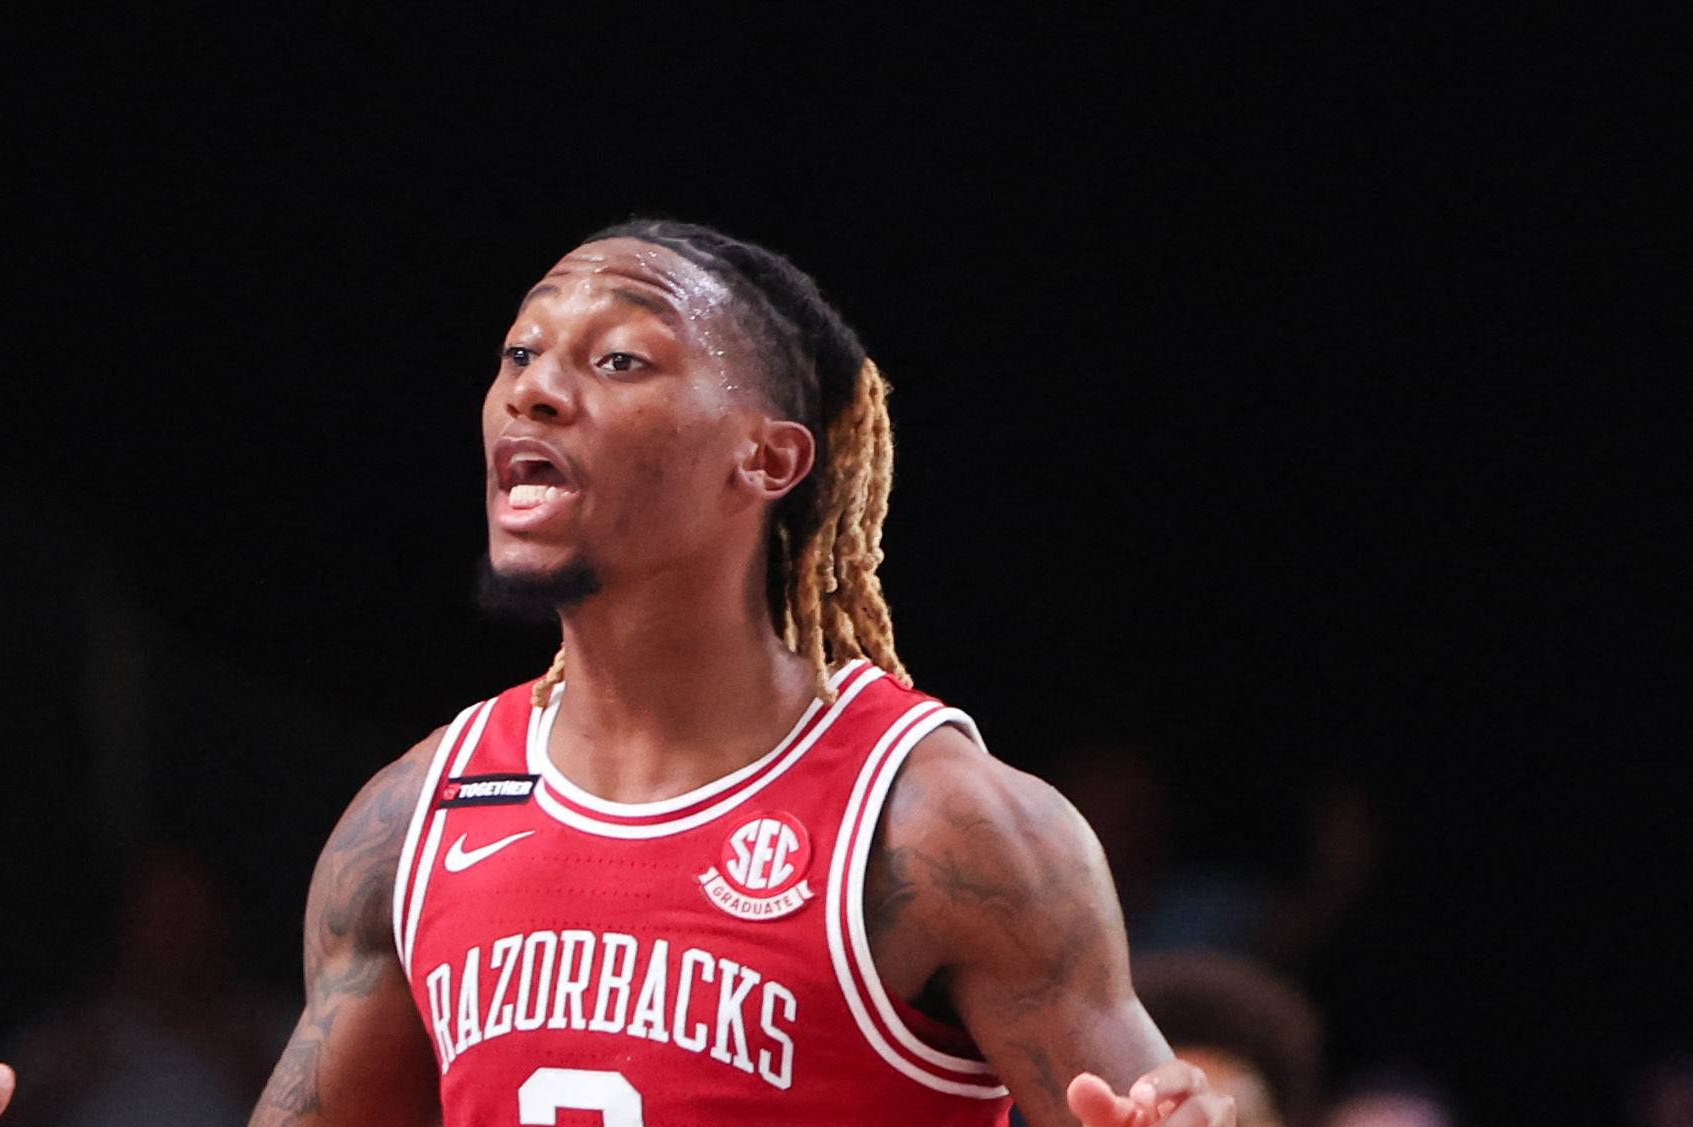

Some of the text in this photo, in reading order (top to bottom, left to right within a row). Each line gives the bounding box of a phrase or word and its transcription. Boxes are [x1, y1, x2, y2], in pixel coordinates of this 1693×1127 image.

[458, 780, 533, 798] TOGETHER
[726, 818, 800, 890] SEC
[712, 886, 793, 914] GRADUATE
[426, 929, 797, 1091] RAZORBACKS
